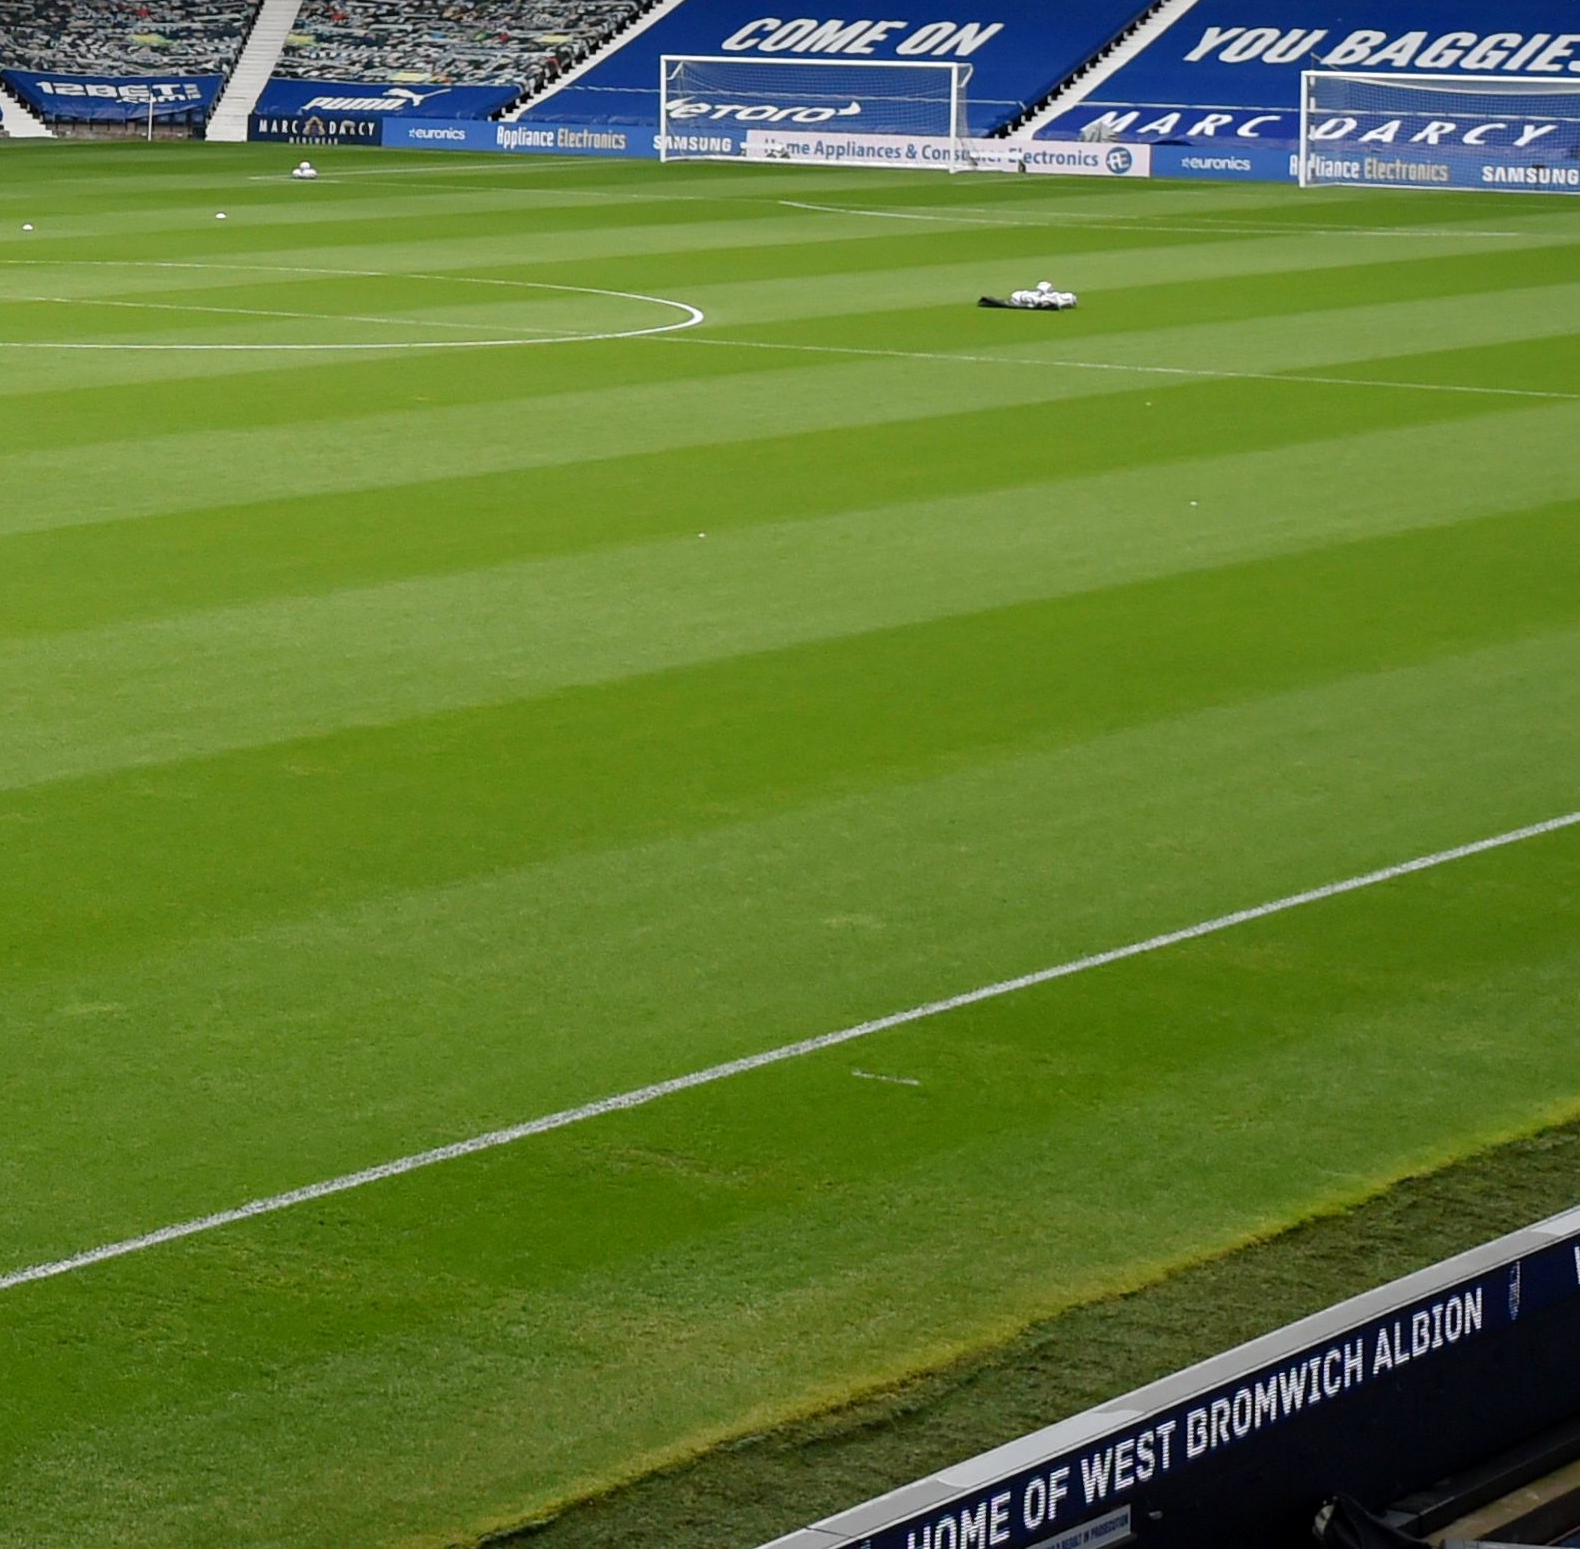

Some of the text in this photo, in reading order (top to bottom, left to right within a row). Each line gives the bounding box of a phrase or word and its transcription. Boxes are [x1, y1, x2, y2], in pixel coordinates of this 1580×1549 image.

[720, 16, 1005, 57] COME ON
[1183, 26, 1329, 64] YOU
[35, 81, 183, 100] 12BET
[258, 118, 299, 135] MARC
[415, 127, 467, 141] euronics
[496, 125, 627, 150] Appliance Electronics
[1079, 110, 1559, 147] MARC DARCY
[814, 140, 1099, 167] Appliances & Eectronics
[1190, 155, 1251, 171] euronics
[1363, 157, 1450, 183] Electronics
[1481, 165, 1579, 186] SAMSUNG
[1022, 1464, 1071, 1530] OF
[1080, 1420, 1177, 1505] WEST
[1185, 1337, 1364, 1460] BROMWICH
[1372, 1287, 1483, 1377] ALBION
